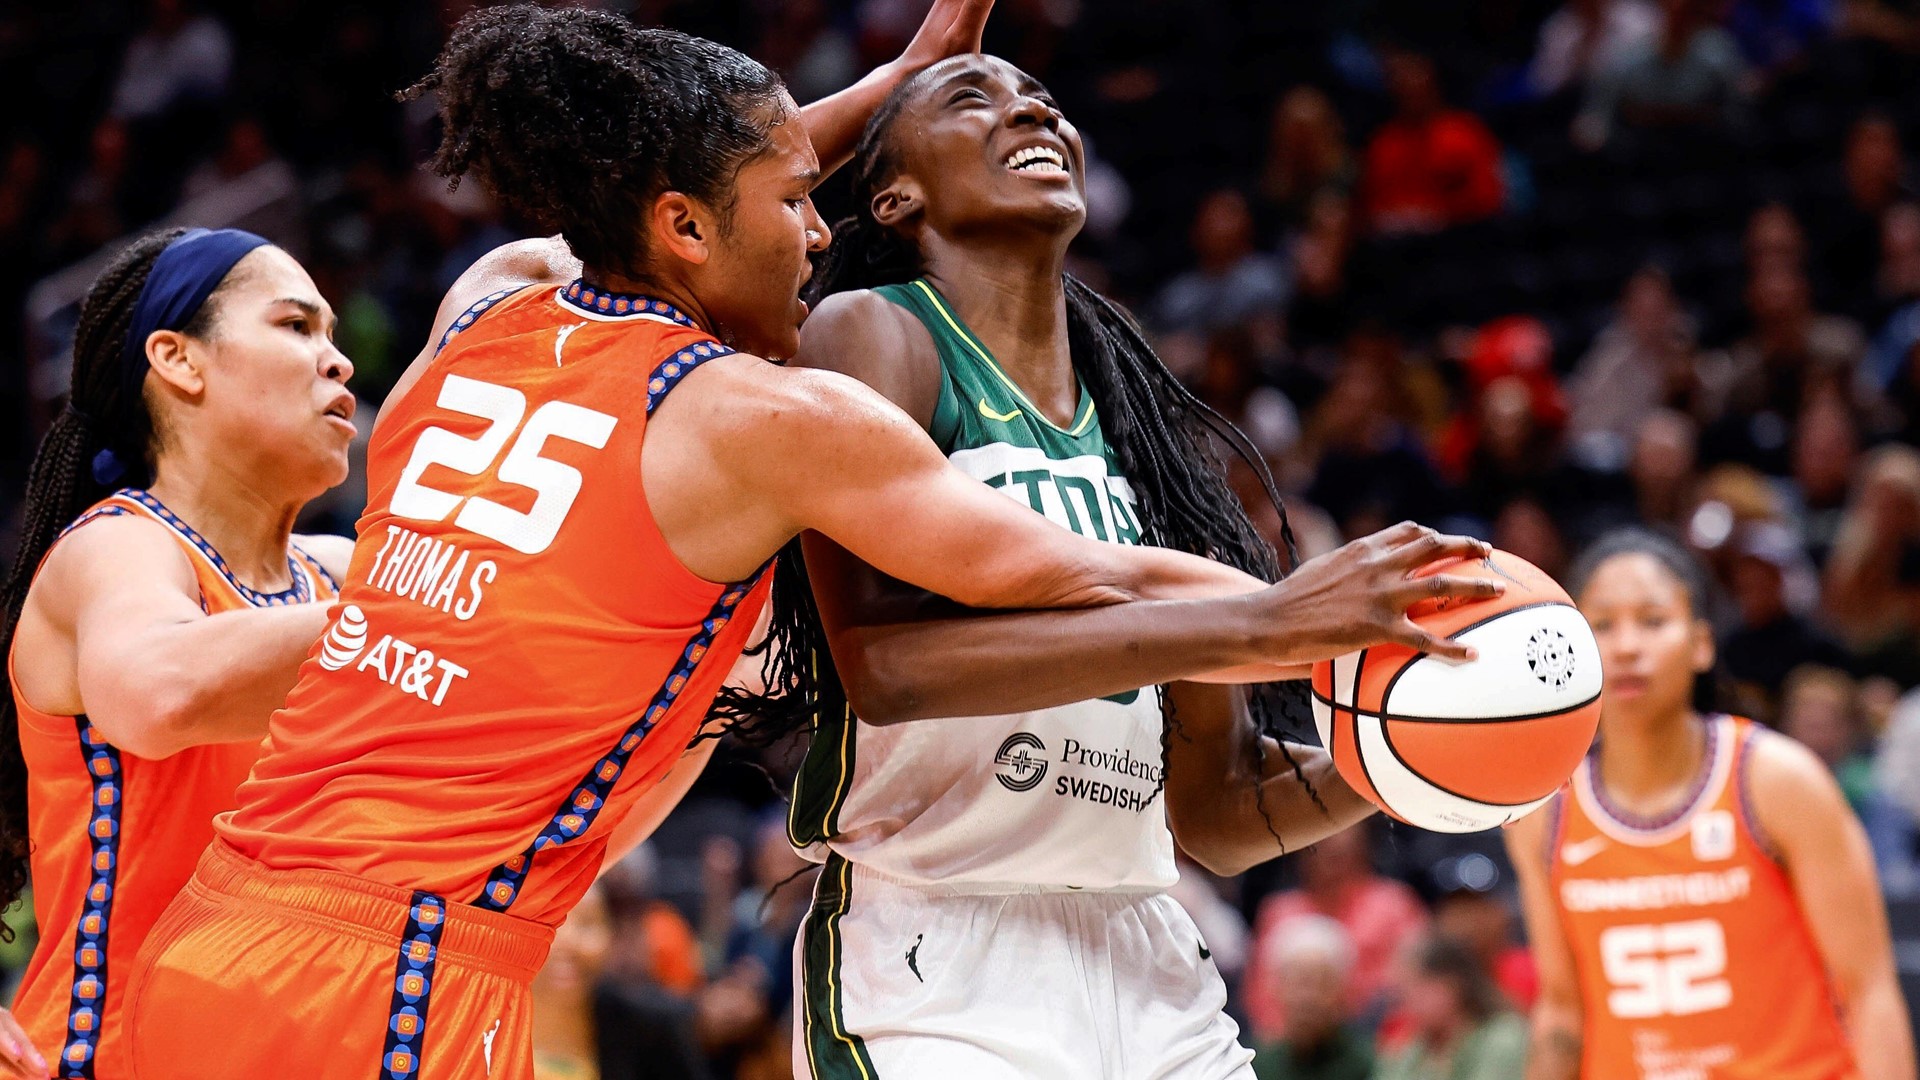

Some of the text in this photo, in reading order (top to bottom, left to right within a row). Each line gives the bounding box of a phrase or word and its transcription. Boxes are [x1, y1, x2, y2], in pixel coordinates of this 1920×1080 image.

[389, 373, 619, 555] 25
[366, 525, 498, 621] THOMAS
[357, 635, 470, 707] AT&T
[1055, 776, 1141, 812] SWEDISH
[1600, 918, 1733, 1018] 52
